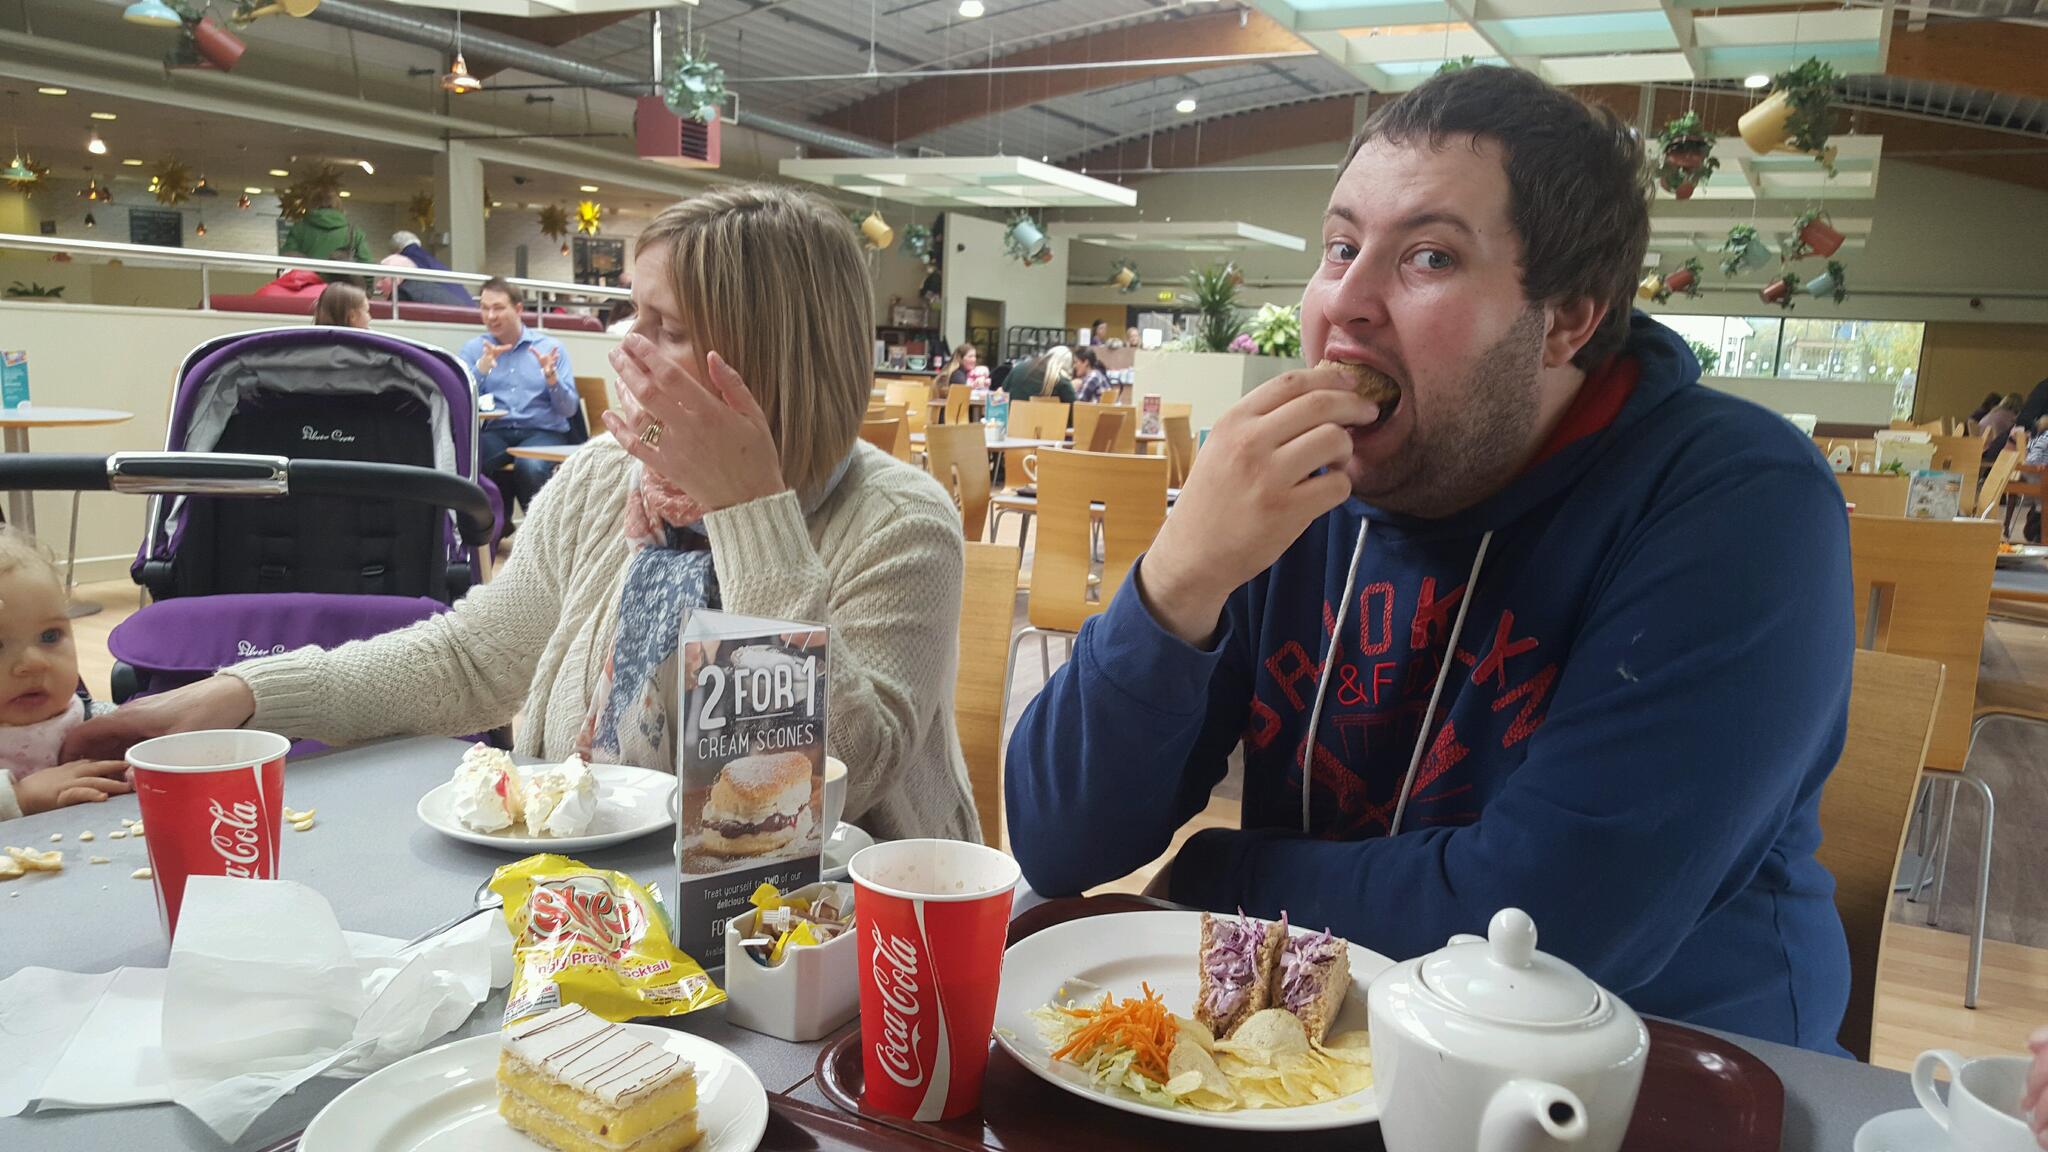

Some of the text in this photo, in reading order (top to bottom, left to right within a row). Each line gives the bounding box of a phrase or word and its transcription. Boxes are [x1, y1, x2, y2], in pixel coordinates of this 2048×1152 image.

[698, 655, 816, 730] 2 FOR 1
[698, 723, 814, 760] CREAM SCONES
[704, 889, 723, 900] Treat
[724, 881, 753, 897] yourself
[764, 875, 780, 885] TWO
[781, 874, 788, 883] of
[791, 872, 802, 881] our
[717, 896, 745, 909] delicious
[711, 917, 732, 938] FO
